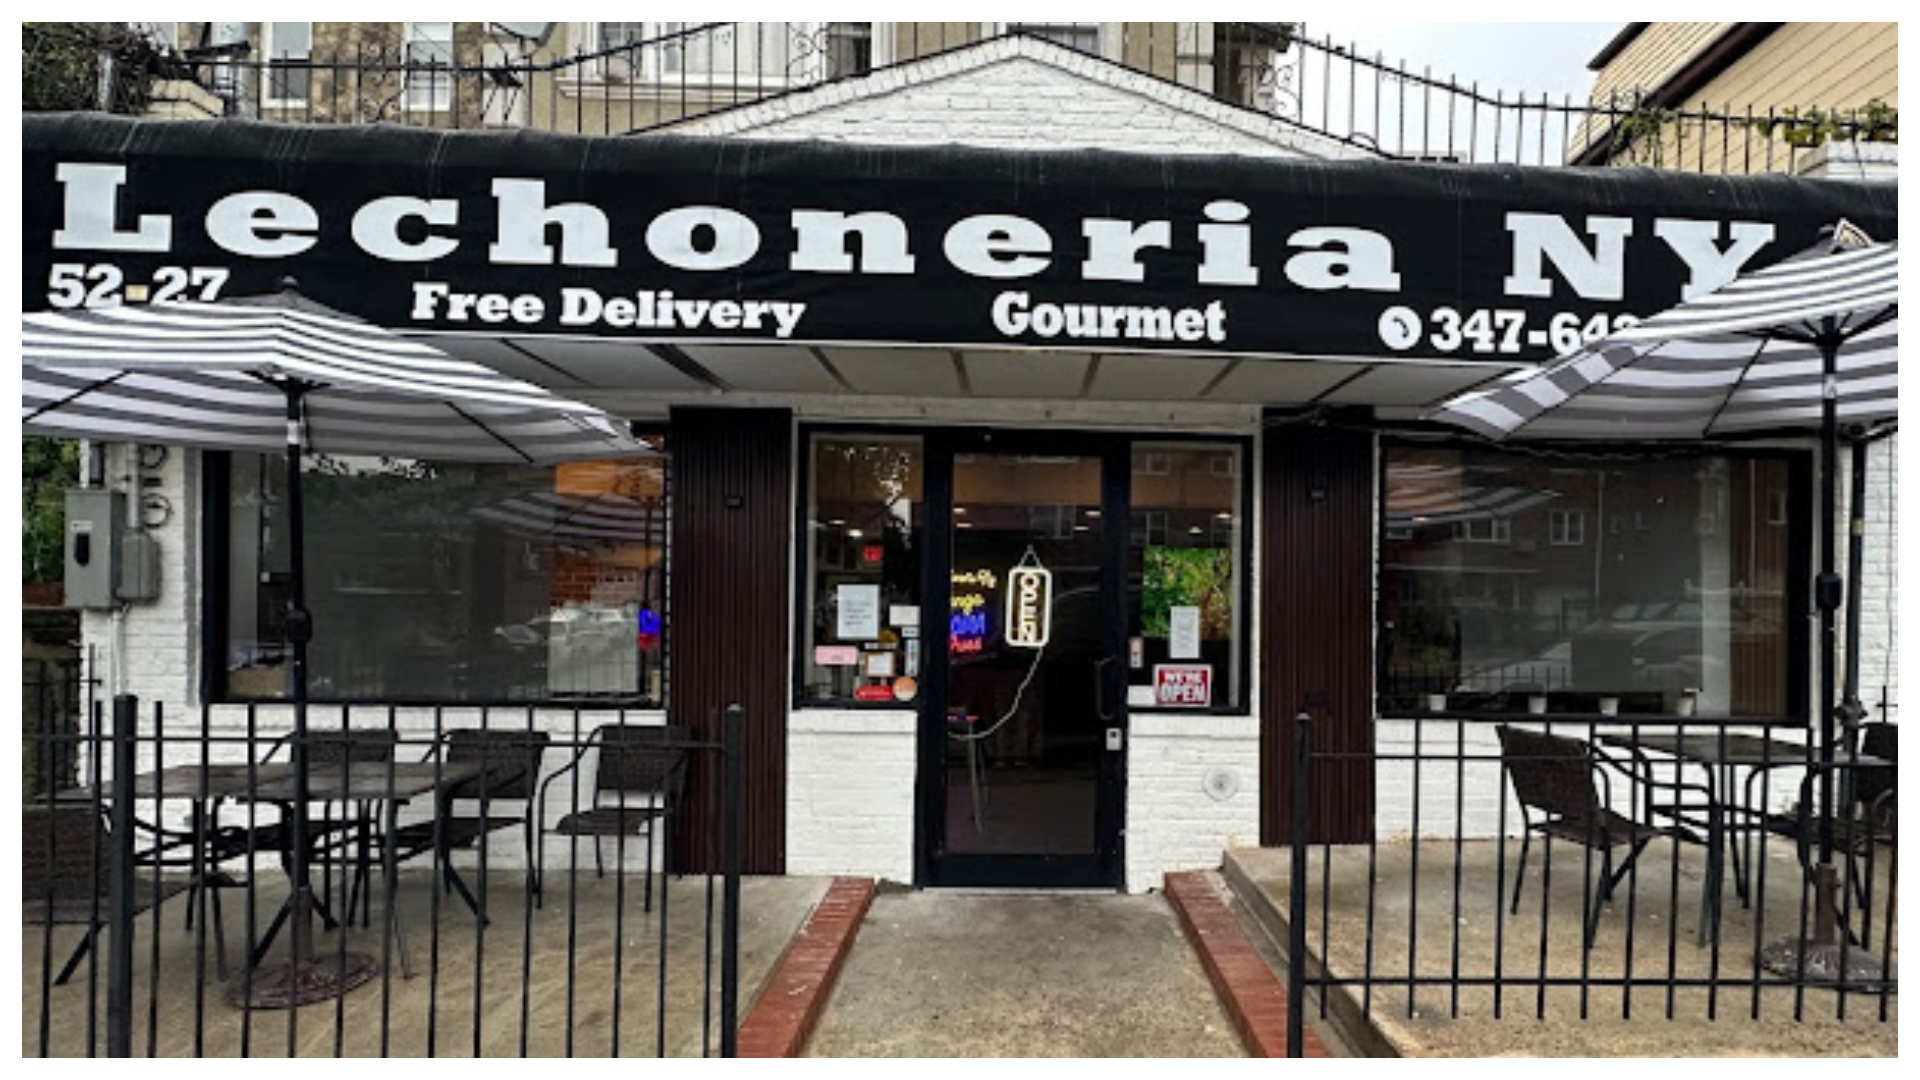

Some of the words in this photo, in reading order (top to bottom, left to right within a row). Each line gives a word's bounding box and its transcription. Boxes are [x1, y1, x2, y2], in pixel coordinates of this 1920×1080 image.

[52, 162, 1401, 292] Lechoneria
[1503, 211, 1777, 303] NY
[47, 263, 230, 309] 52-27
[411, 282, 545, 323] Free
[559, 287, 806, 338] Delivery
[991, 291, 1227, 341] Gourmet
[1019, 574, 1040, 643] OPEN
[1160, 684, 1206, 703] OPEN
